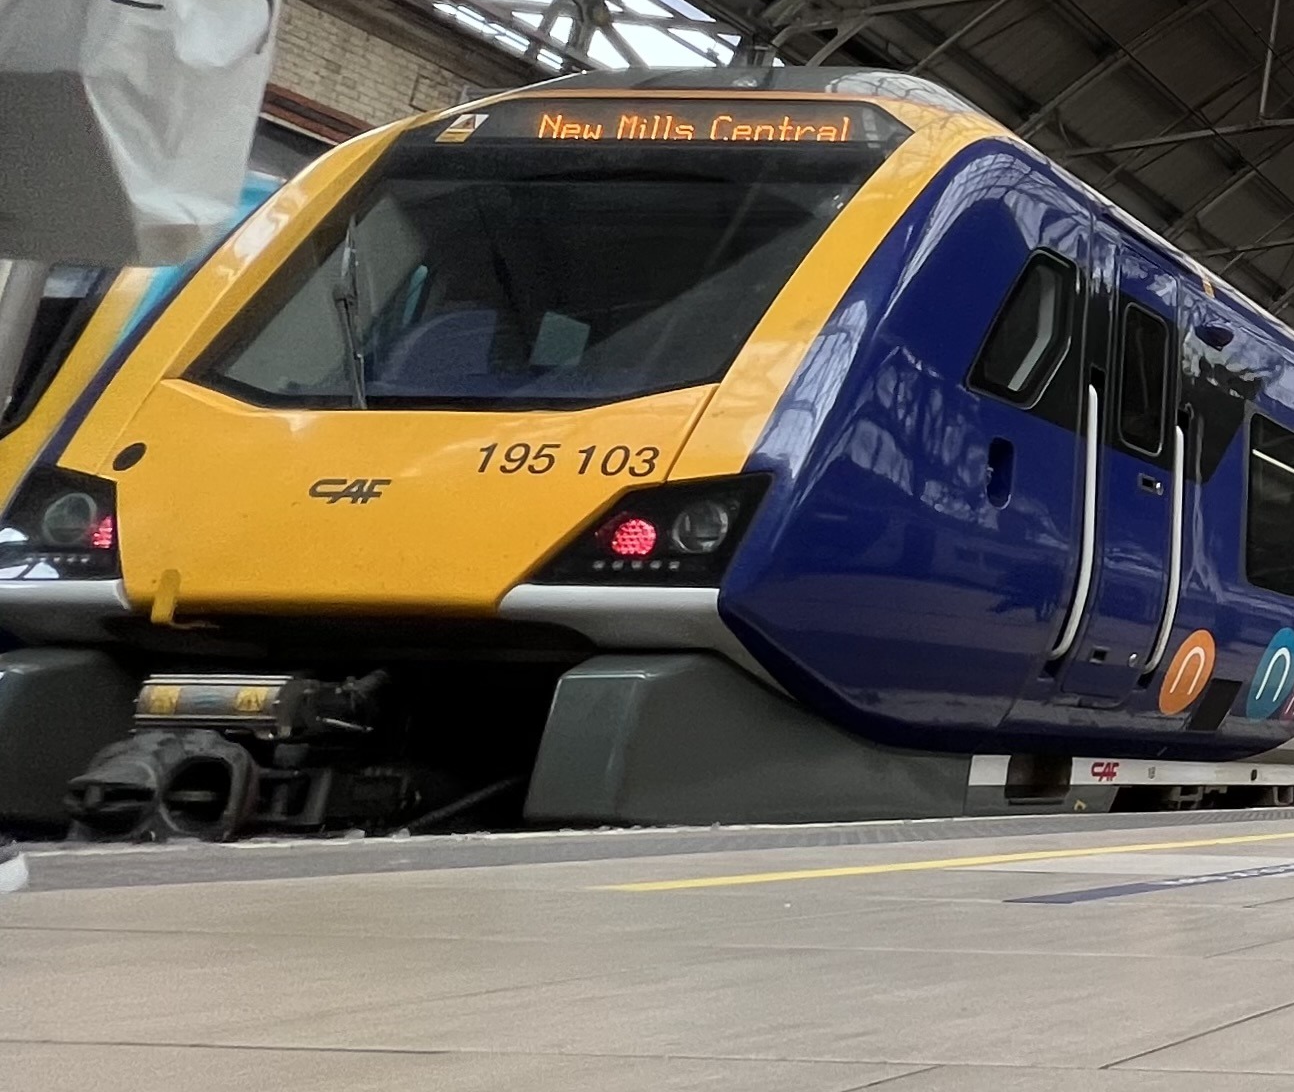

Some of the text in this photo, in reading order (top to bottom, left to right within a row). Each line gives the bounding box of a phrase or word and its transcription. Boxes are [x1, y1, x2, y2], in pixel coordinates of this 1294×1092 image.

[537, 114, 850, 142] New Mills Central
[476, 442, 661, 478] 195 103
[308, 478, 393, 505] CAF
[1090, 761, 1120, 782] CAF
